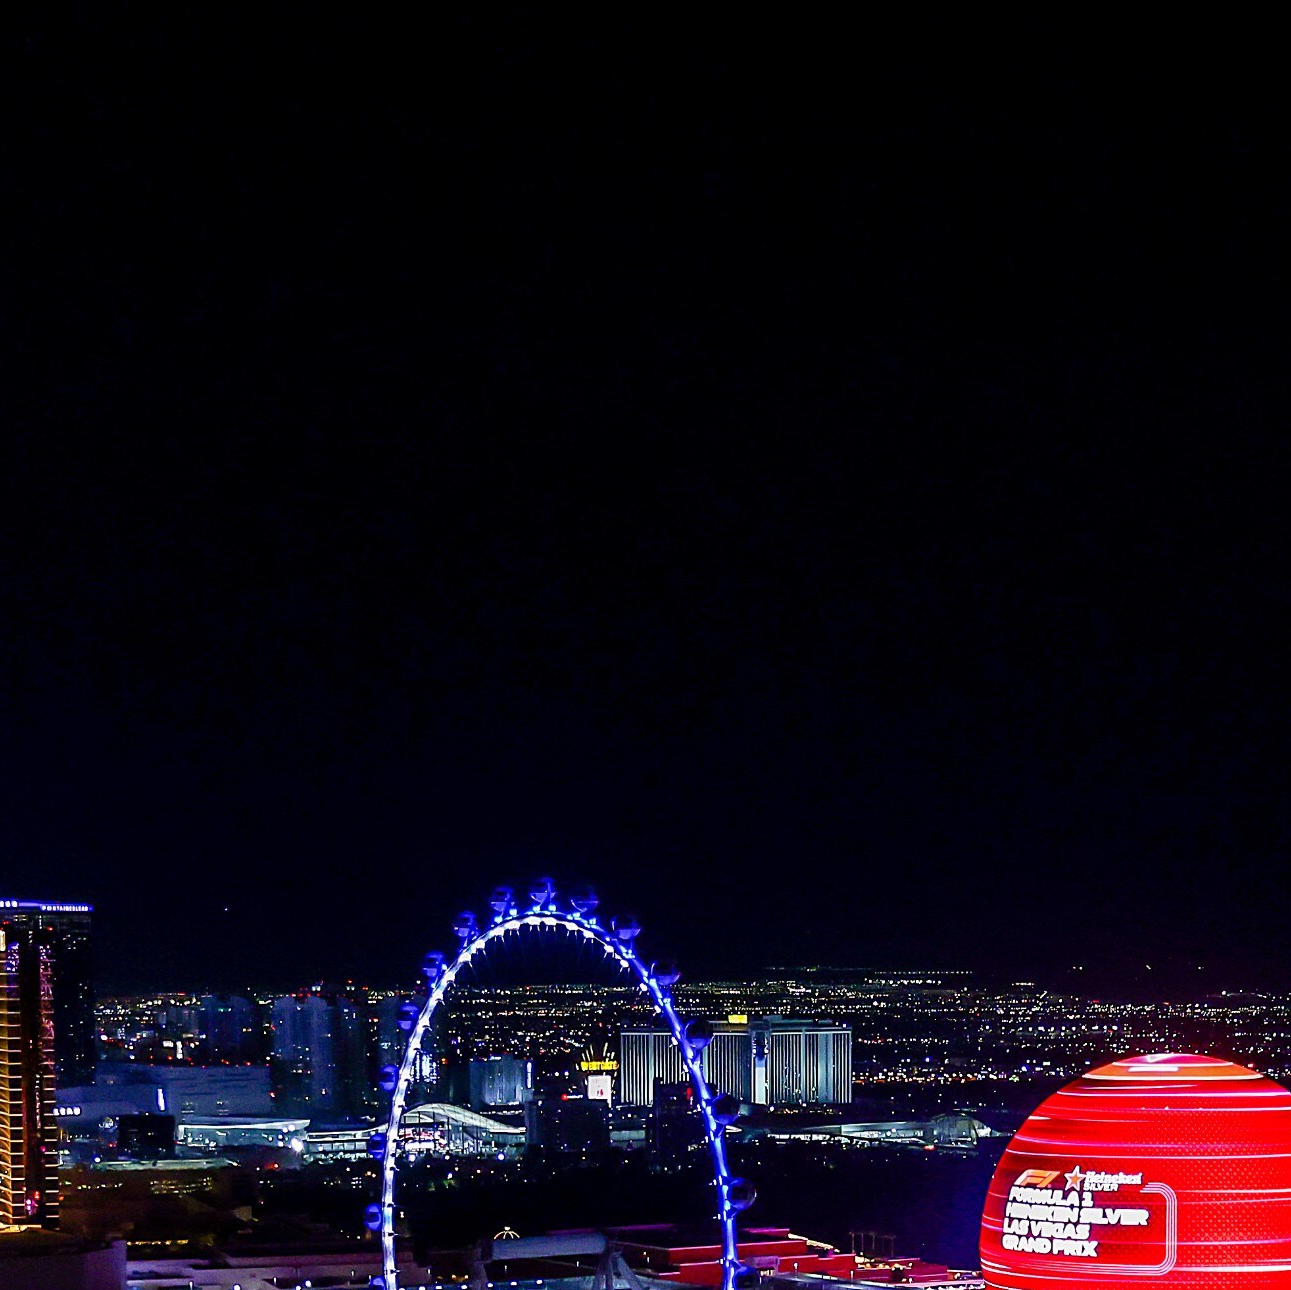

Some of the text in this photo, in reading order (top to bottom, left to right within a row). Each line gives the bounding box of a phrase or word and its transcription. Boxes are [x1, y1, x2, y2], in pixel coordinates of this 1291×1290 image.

[1009, 1186, 1080, 1207] FORMULA
[1079, 1207, 1150, 1226] SILVER
[1003, 1217, 1091, 1240] LAS VEGAS
[1002, 1234, 1099, 1258] GRAND PRIX
